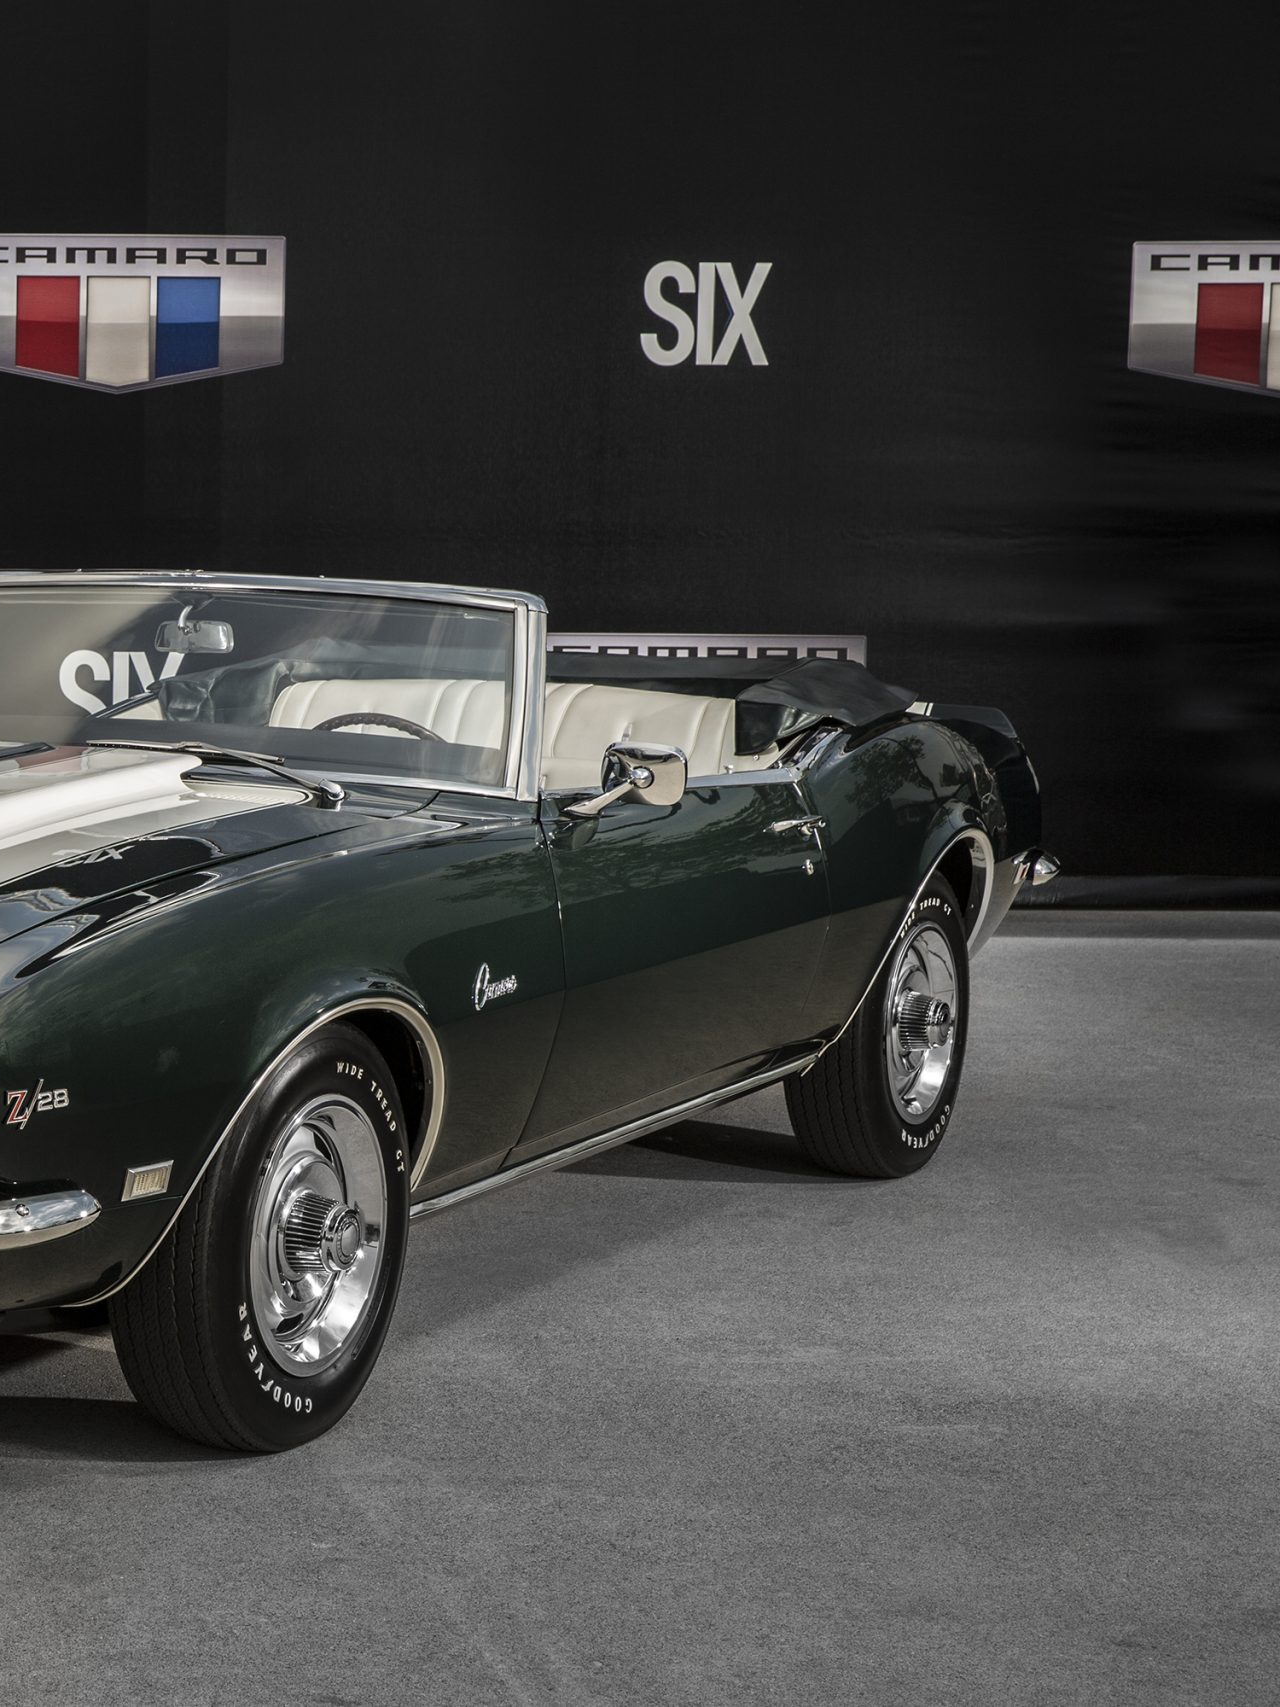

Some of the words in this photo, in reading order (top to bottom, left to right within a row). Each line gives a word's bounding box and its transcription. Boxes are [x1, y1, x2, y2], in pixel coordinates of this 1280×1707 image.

[640, 260, 773, 366] SIX
[6, 1078, 70, 1129] Z/28
[336, 1061, 364, 1080] WIDE
[371, 1080, 397, 1131] TREAD
[396, 1149, 405, 1172] GT
[901, 1104, 950, 1149] GOODYEAR
[238, 1302, 313, 1414] GOODYEAR
